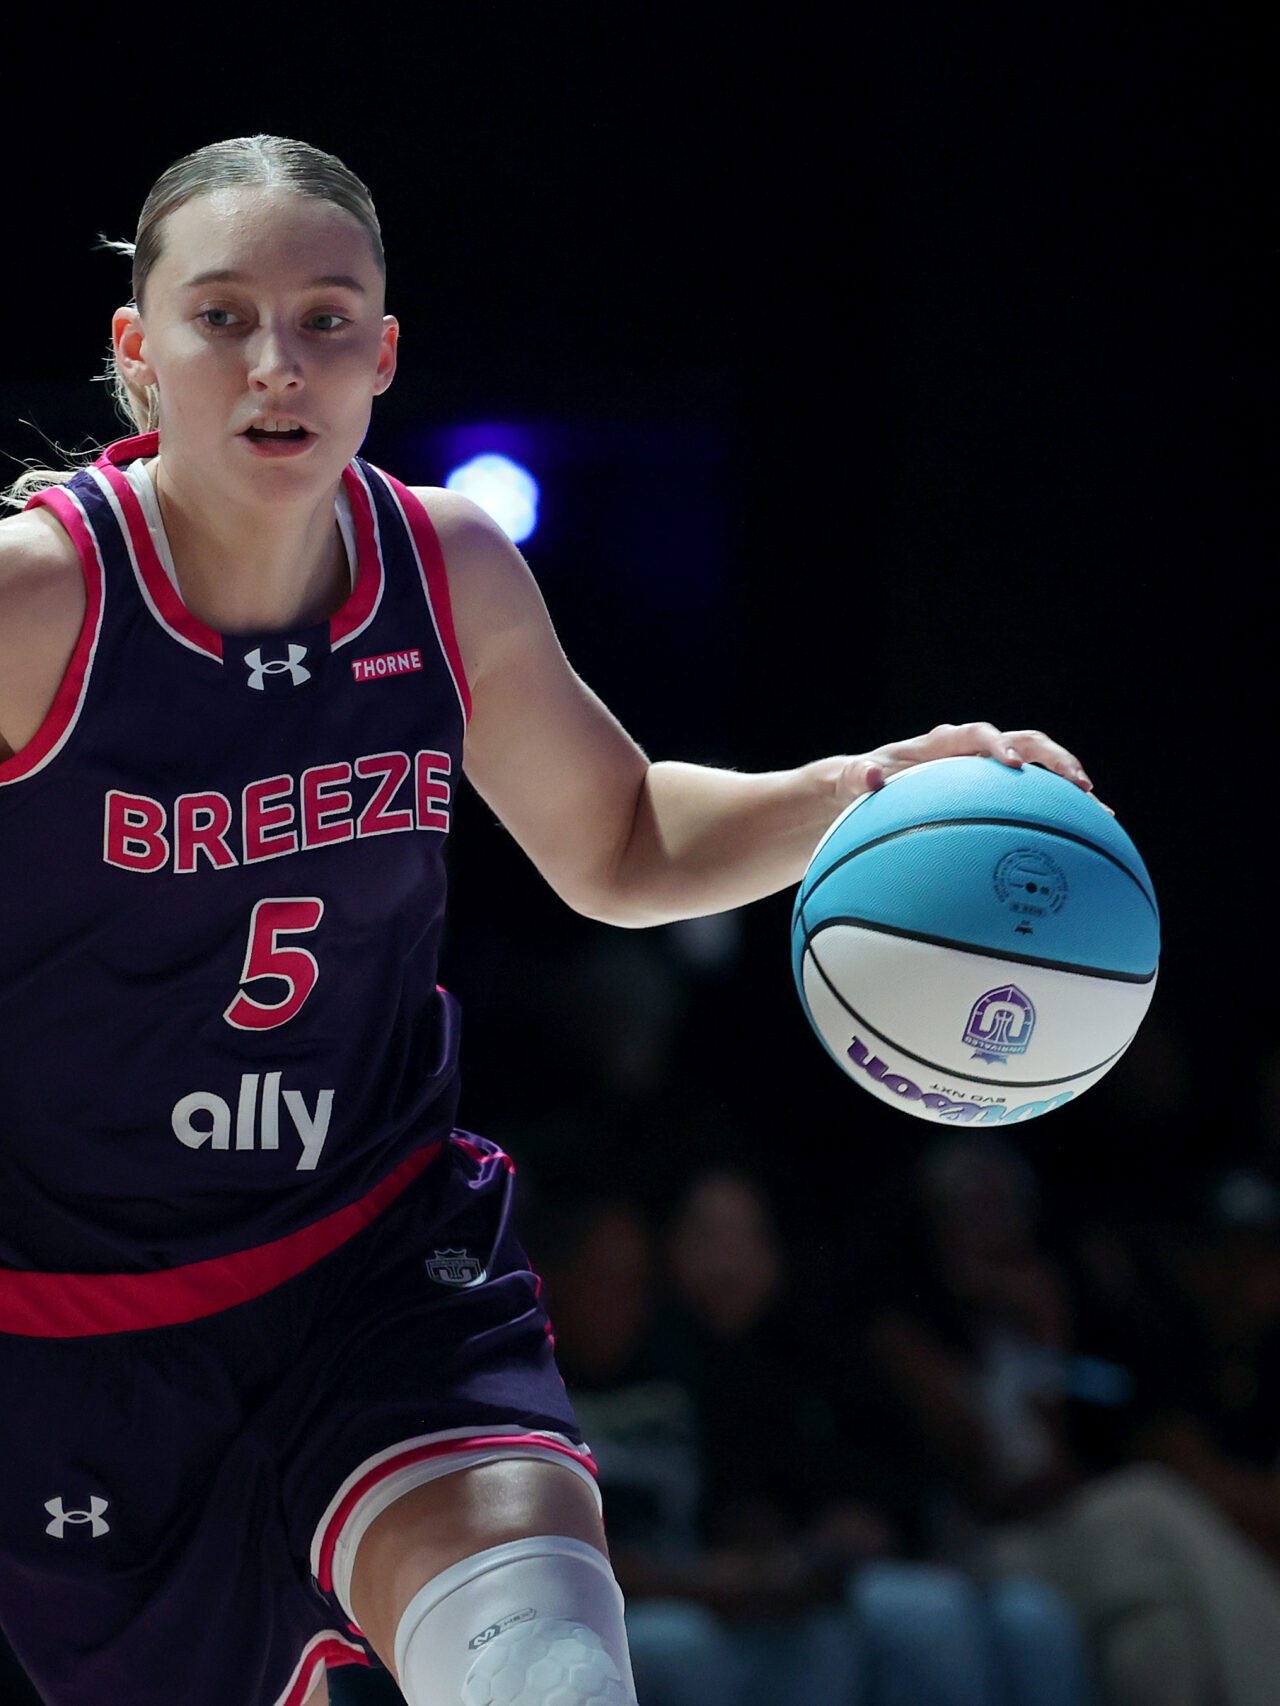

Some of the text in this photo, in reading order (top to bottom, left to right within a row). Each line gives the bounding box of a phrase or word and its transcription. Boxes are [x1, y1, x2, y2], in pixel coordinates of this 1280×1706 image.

[352, 650, 421, 679] THORNE
[103, 749, 451, 873] BREEZE
[223, 897, 324, 1031] 5
[964, 1036, 1025, 1053] UNRIVALED
[171, 1071, 335, 1170] ally
[928, 1082, 1007, 1104] EVO NXT
